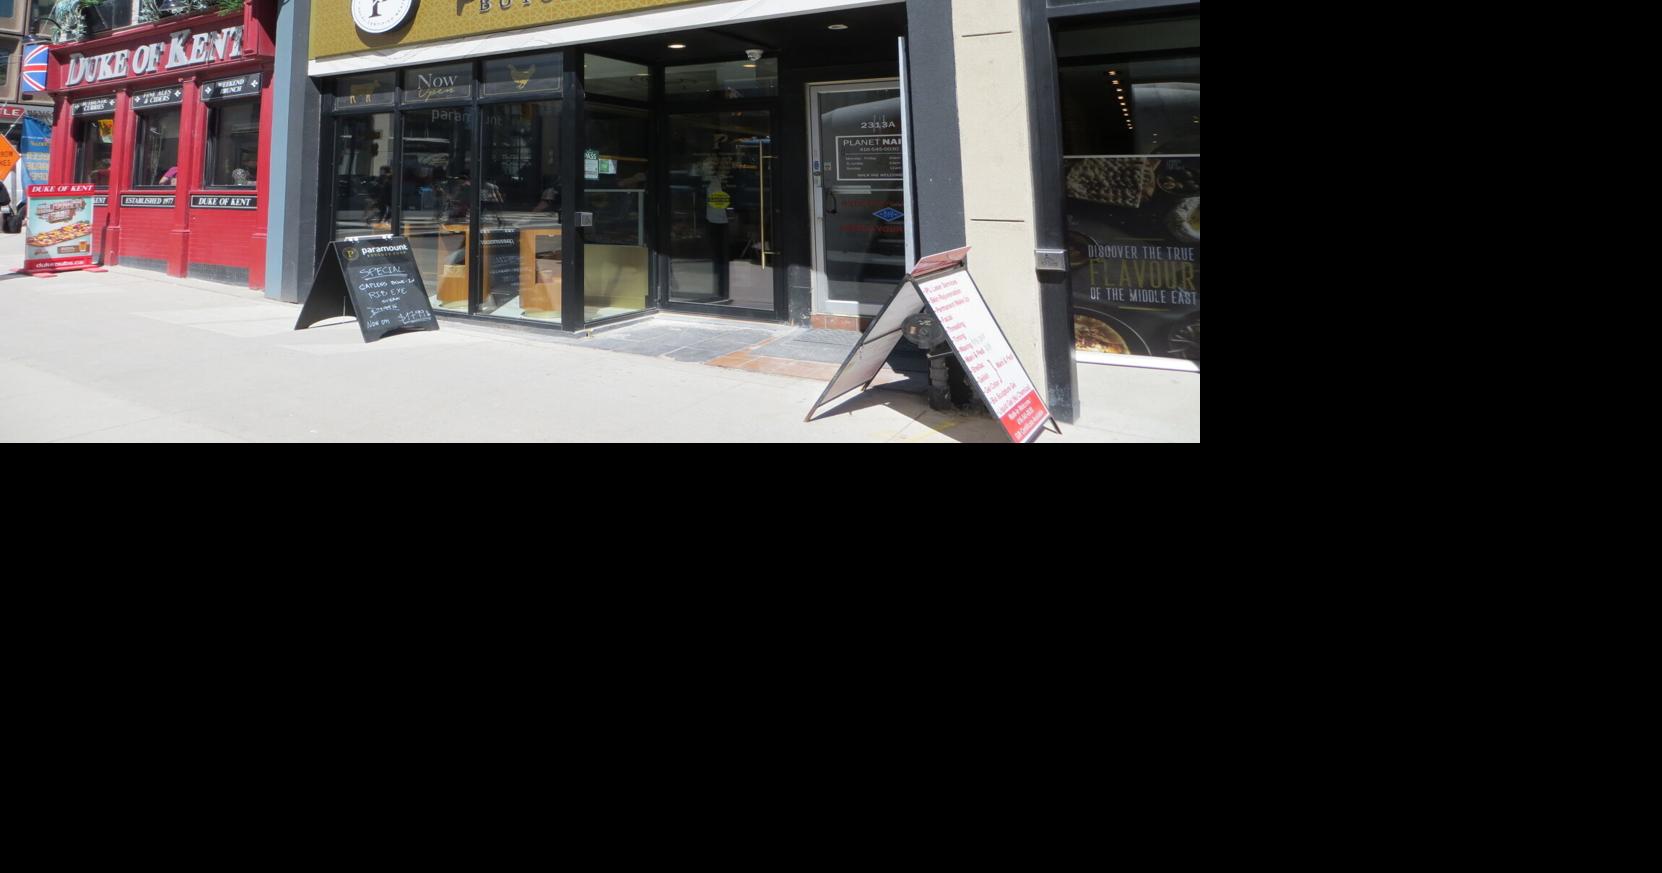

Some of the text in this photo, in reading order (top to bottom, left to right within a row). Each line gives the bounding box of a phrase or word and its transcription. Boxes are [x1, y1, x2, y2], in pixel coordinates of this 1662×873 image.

[65, 25, 244, 86] DUKE OF KENT
[416, 74, 458, 89] Now
[860, 121, 896, 129] 2313A
[125, 197, 162, 205] ESTABLISHED
[198, 197, 251, 206] DUKE OF KENT
[361, 244, 408, 256] paramount
[1088, 245, 1195, 261] DISCOVER THE TRUE
[360, 266, 406, 279] SPECIAL
[1089, 258, 1195, 290] FLAVOUR
[1090, 287, 1197, 305] OF THE MIDDLE EAST
